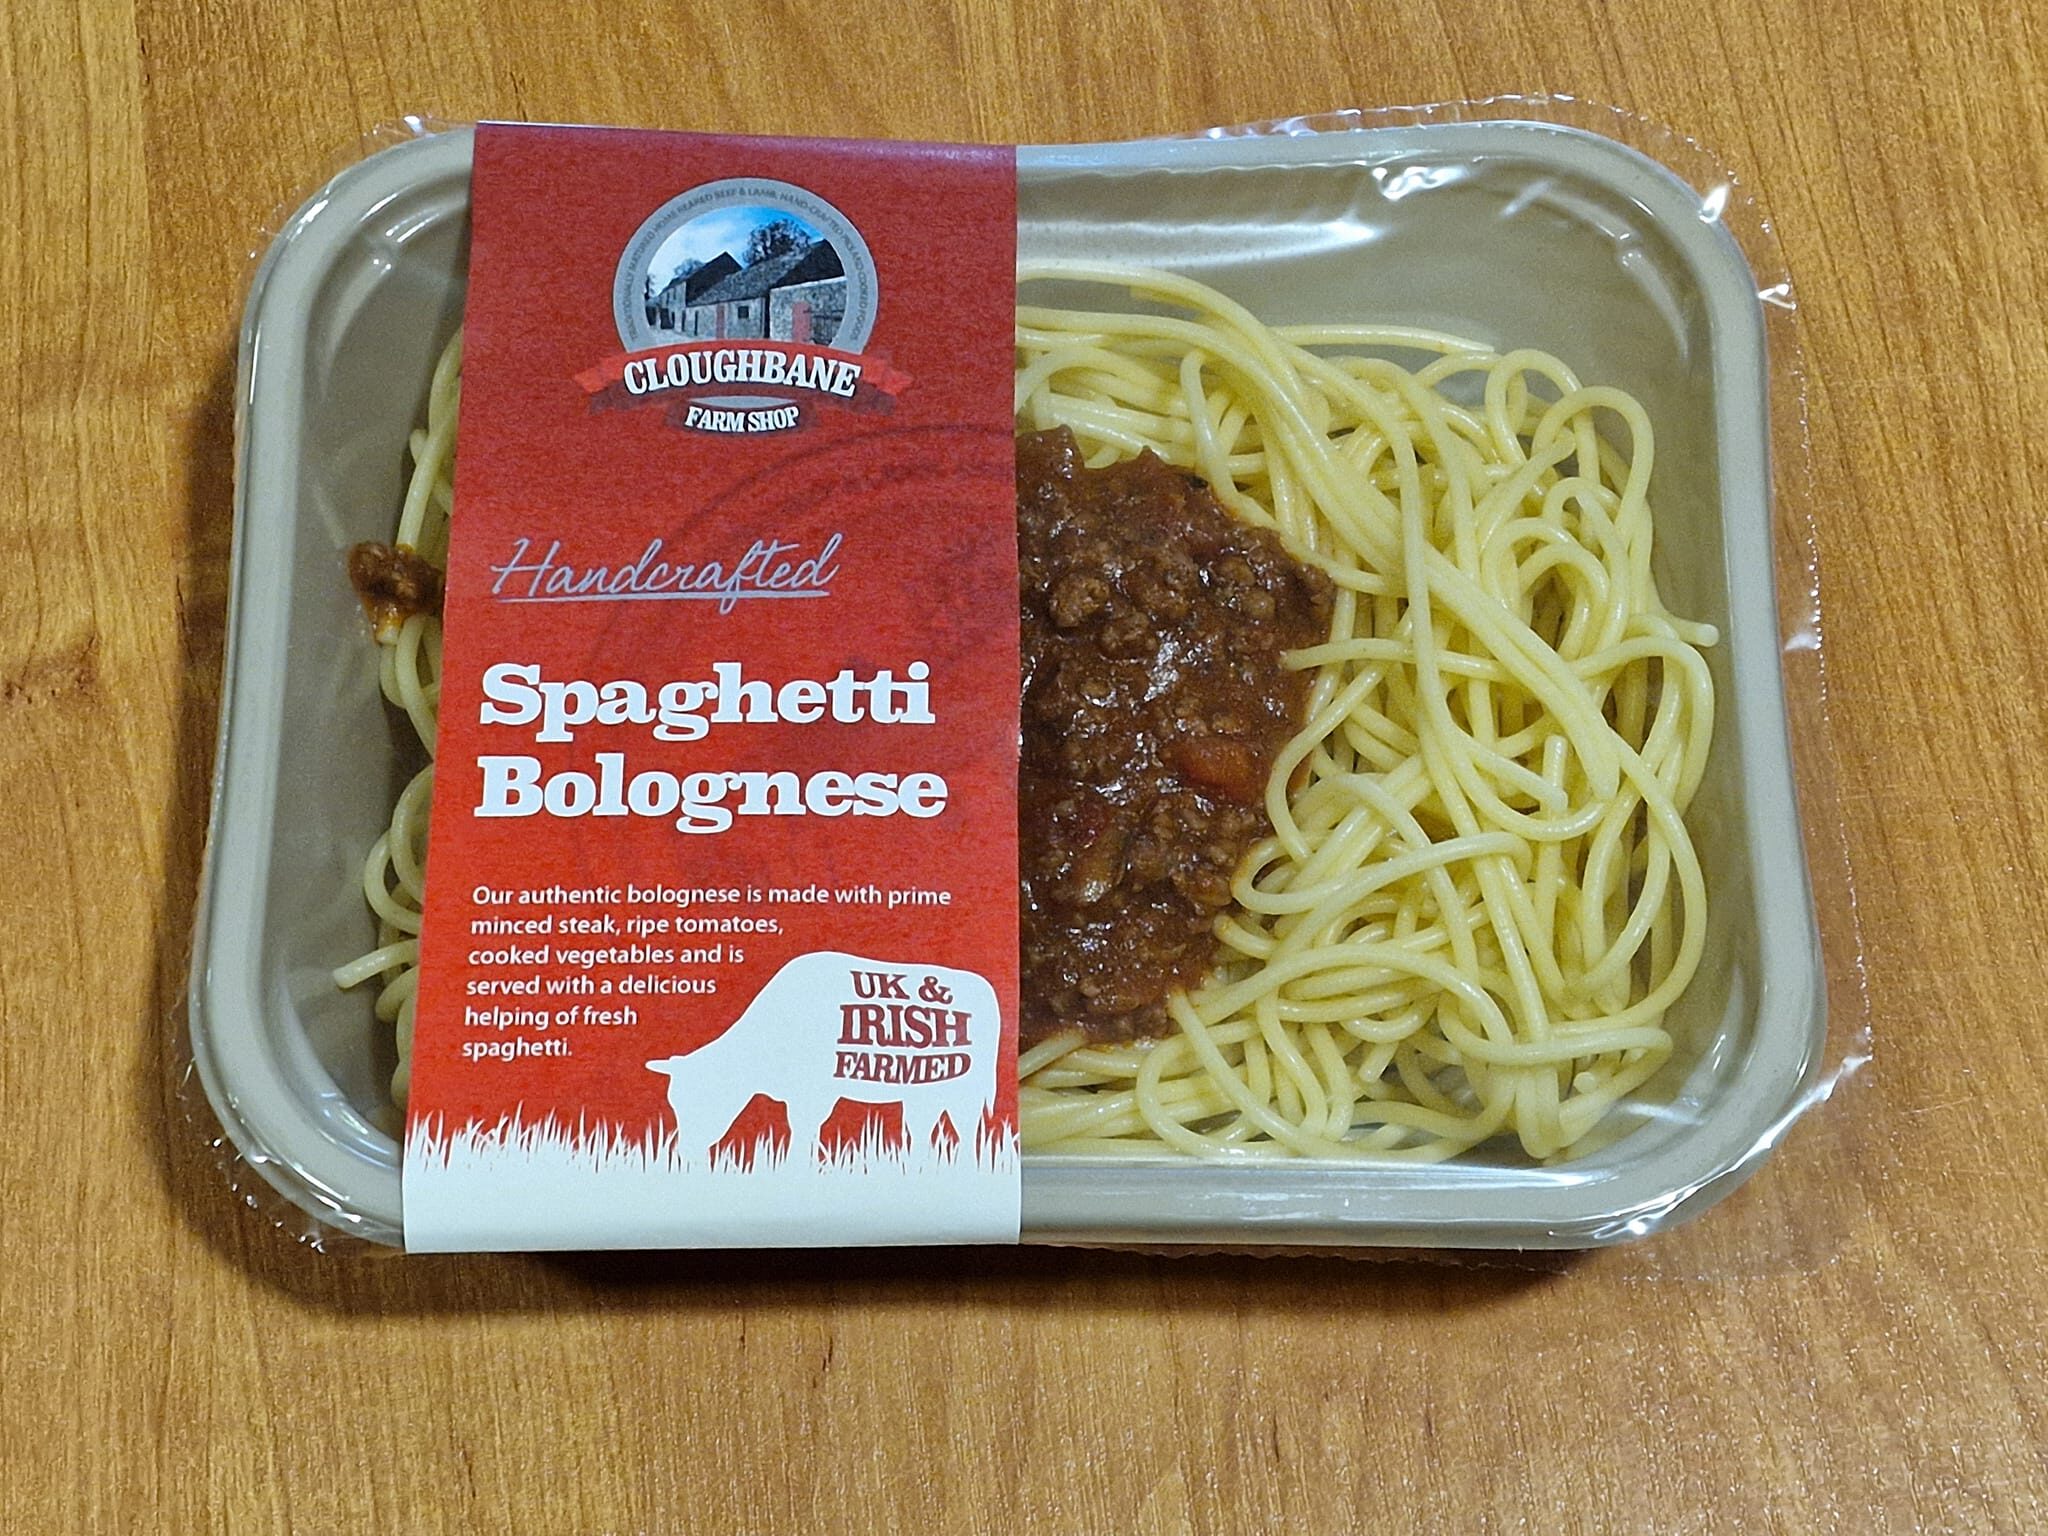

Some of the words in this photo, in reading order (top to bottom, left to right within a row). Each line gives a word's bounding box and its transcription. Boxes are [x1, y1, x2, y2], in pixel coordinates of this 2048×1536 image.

[624, 349, 862, 398] CLOUGHBANE
[685, 406, 745, 433] FARM
[747, 406, 799, 432] SHOP
[491, 533, 842, 614] Handcrafted
[480, 660, 935, 743] Spaghetti
[474, 752, 948, 834] Bolognese
[473, 885, 513, 905] Our
[519, 885, 621, 905] authentic
[628, 884, 740, 908] bolognese
[748, 885, 761, 903] is
[769, 884, 829, 903] made
[835, 885, 881, 904] with
[888, 886, 952, 909] prime
[471, 915, 552, 935] minced
[559, 914, 621, 937] steak,
[627, 915, 669, 939] ripe
[675, 915, 784, 935] tomatoes,
[469, 944, 549, 965] cooked
[556, 944, 674, 969] vegetables
[680, 944, 722, 964] and
[729, 944, 745, 963] is
[467, 975, 541, 995] served
[546, 975, 595, 995] with
[600, 979, 613, 995] a
[619, 974, 717, 995] delicious
[850, 971, 911, 1000] UK
[918, 976, 953, 1004] &
[465, 1006, 549, 1031] helping
[555, 1006, 579, 1026] of
[583, 1006, 638, 1026] fresh
[837, 1004, 972, 1049] IRISH
[462, 1036, 573, 1063] spaghetti.
[833, 1051, 972, 1085] FARMED
